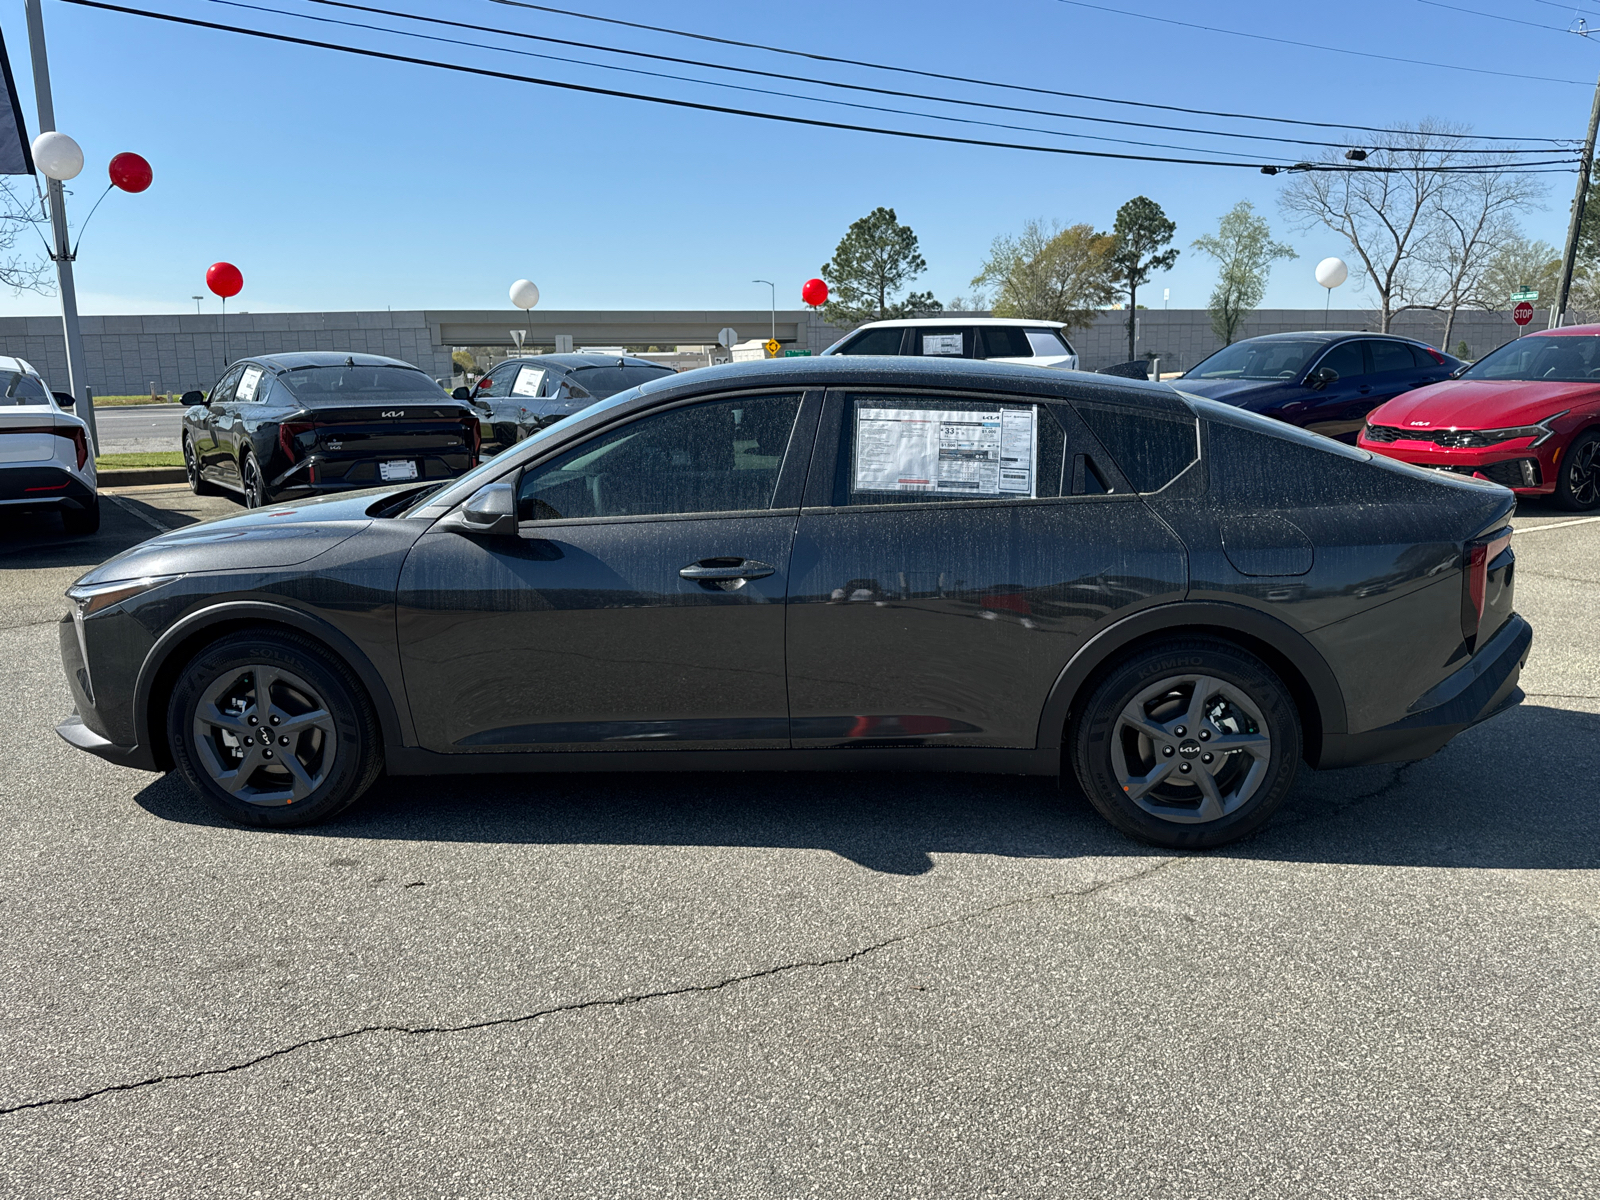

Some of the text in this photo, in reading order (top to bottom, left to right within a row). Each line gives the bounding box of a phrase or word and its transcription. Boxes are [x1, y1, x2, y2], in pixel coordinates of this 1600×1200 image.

[1514, 309, 1533, 319] STOP
[382, 410, 404, 418] KIA
[944, 427, 955, 435] 33
[249, 648, 305, 669] SOLUS
[1138, 656, 1204, 680] KUMHO
[259, 726, 271, 746] KIA
[1179, 746, 1201, 754] KIA
[174, 734, 204, 789] KUMHO
[1262, 752, 1291, 808] SOLUS
